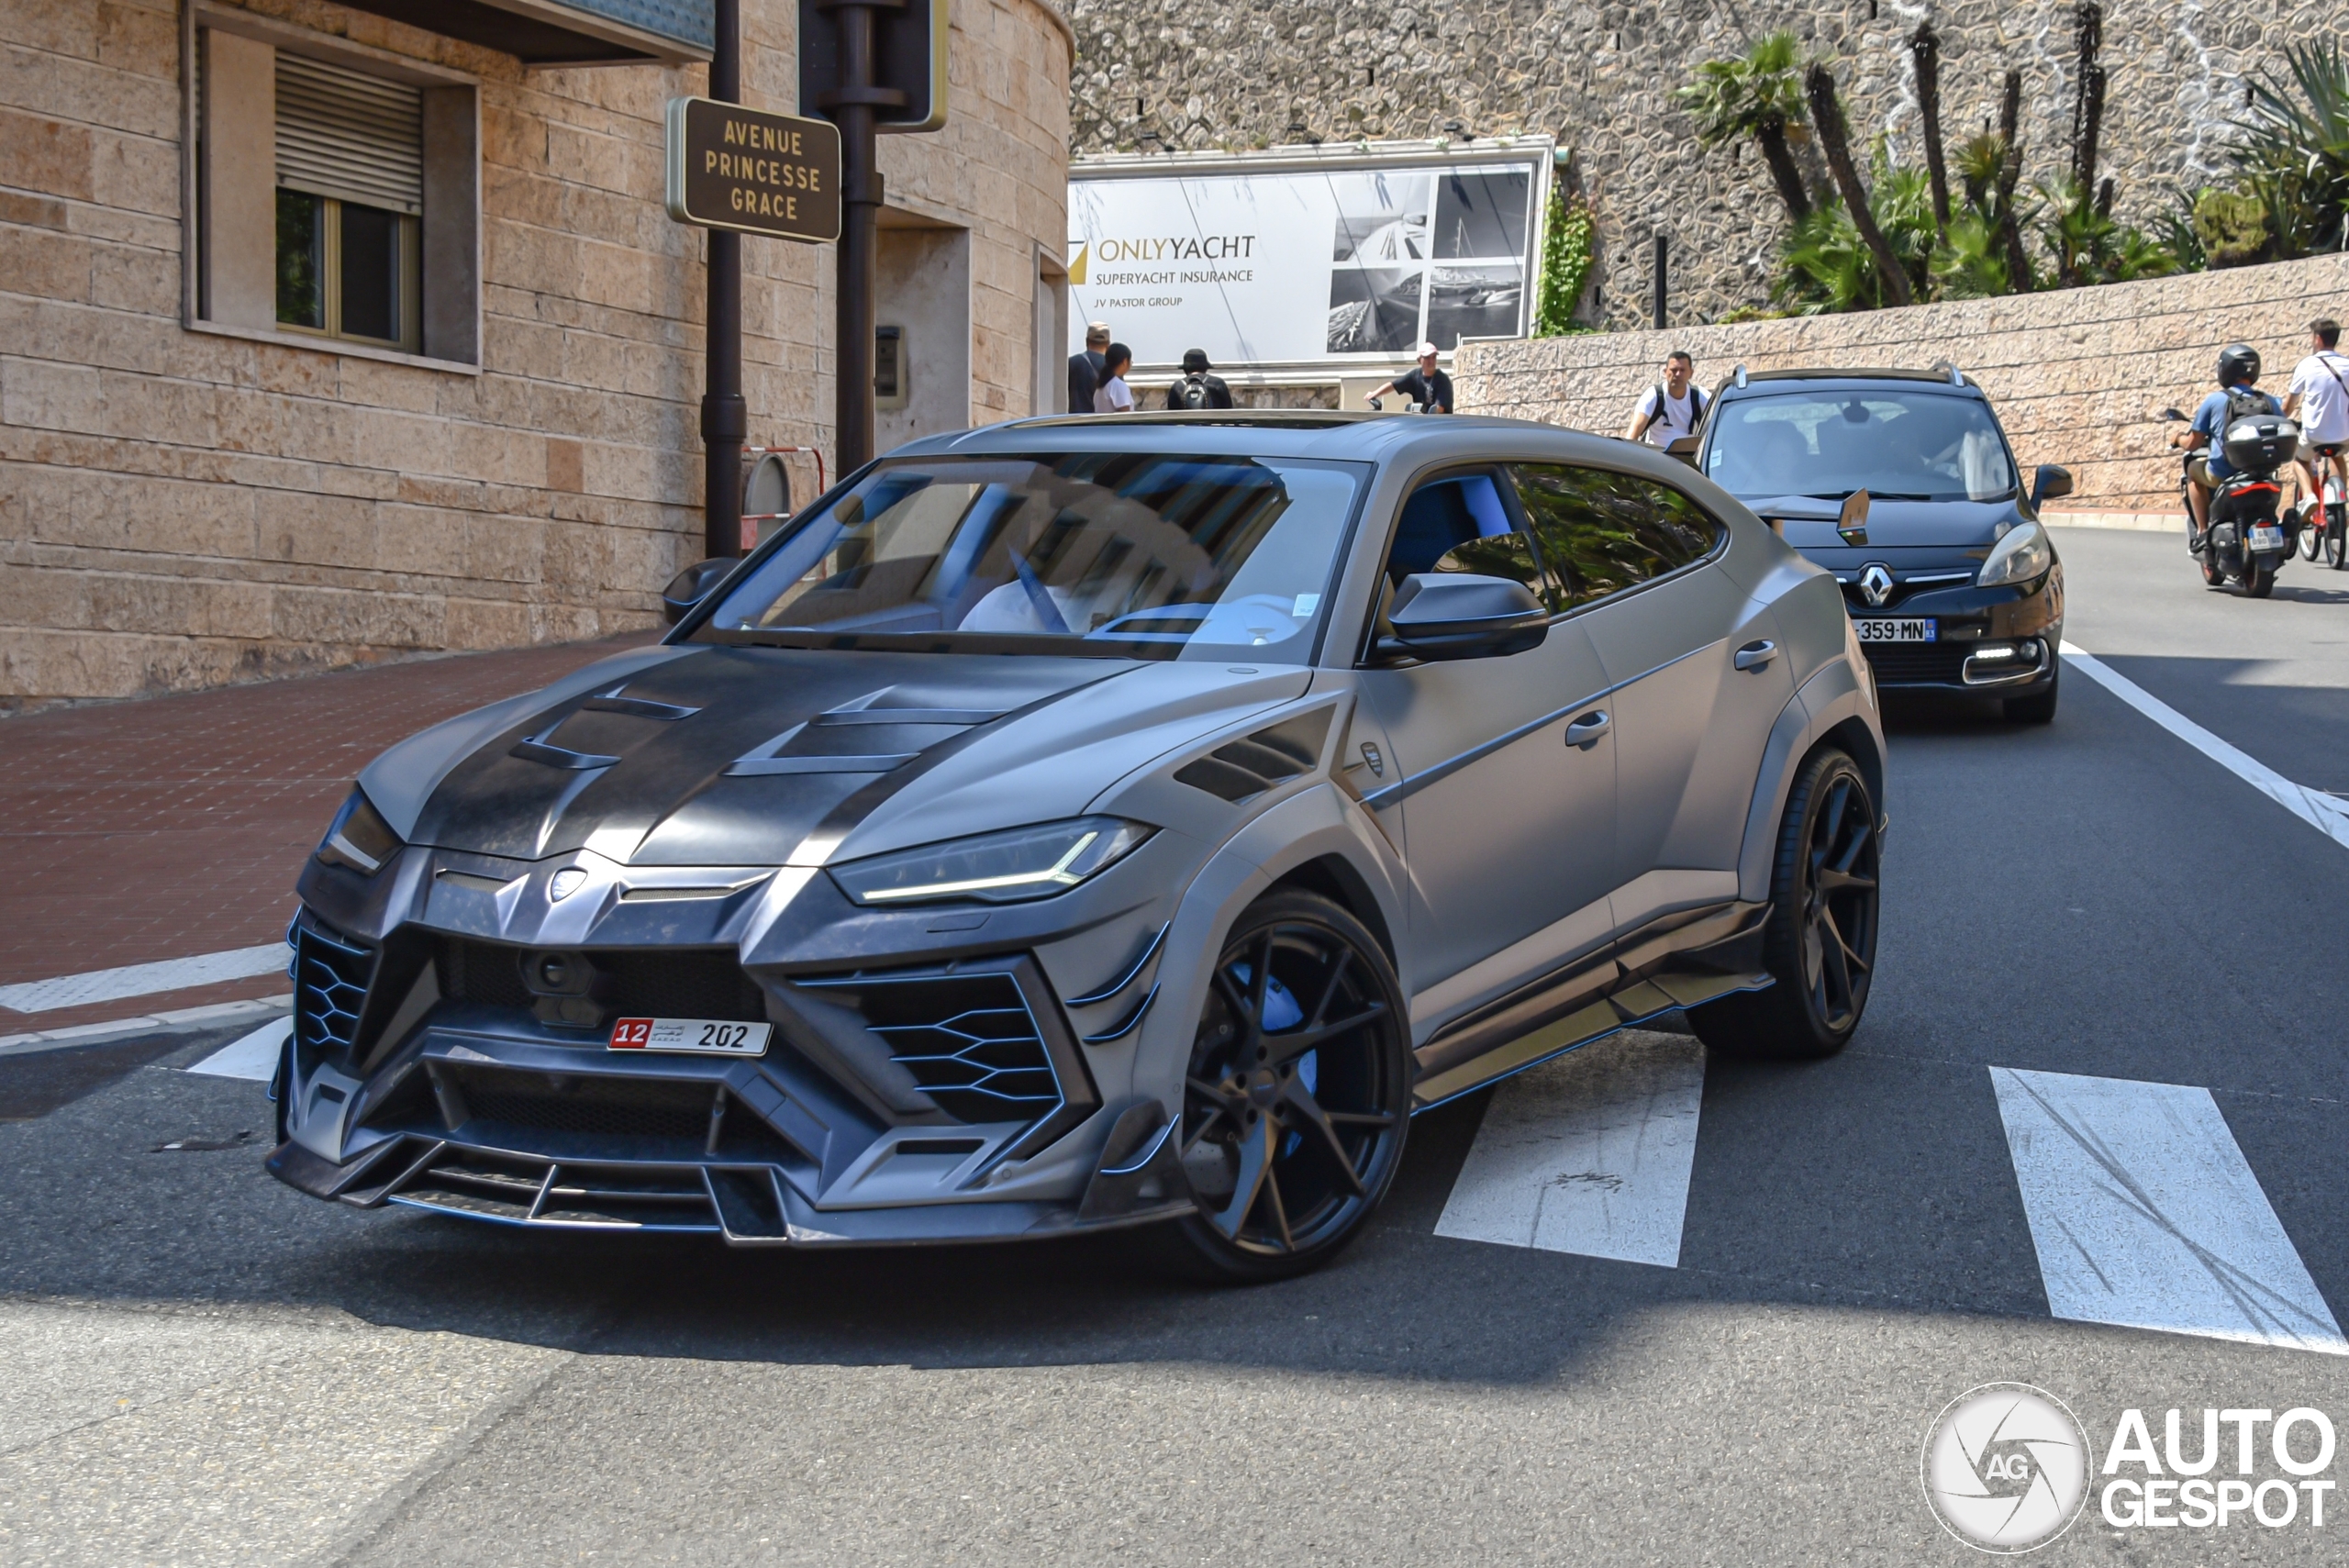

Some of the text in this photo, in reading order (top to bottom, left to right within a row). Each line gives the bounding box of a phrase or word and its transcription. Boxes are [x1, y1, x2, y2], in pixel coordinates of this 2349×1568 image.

[725, 119, 802, 156] AVENUE
[706, 150, 820, 193] PRINCESSE
[731, 187, 797, 220] GRACE
[1098, 235, 1256, 262] ONLYYACHT
[1096, 269, 1253, 285] SUPERYACHT INSURANCE
[1094, 295, 1183, 308] JV PASTOR GROUP
[616, 1024, 748, 1047] 12 202
